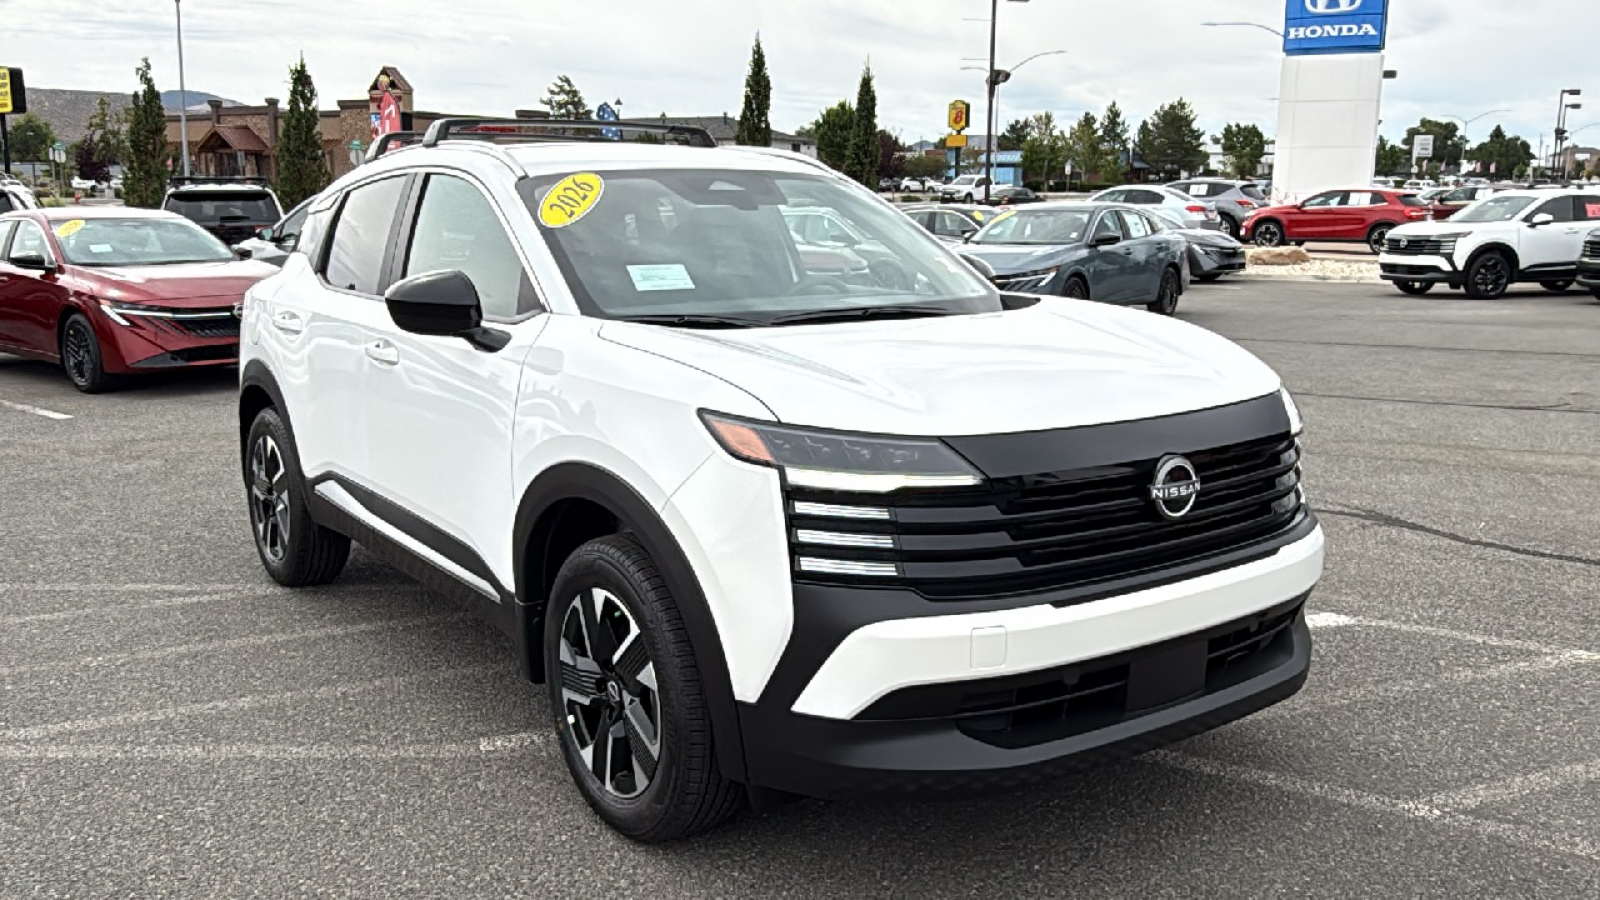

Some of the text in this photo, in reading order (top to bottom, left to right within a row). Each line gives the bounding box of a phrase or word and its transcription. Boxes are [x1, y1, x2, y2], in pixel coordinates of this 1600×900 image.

[1288, 23, 1378, 39] HONDA
[549, 177, 594, 218] 2026
[1152, 481, 1201, 499] NISSAN
